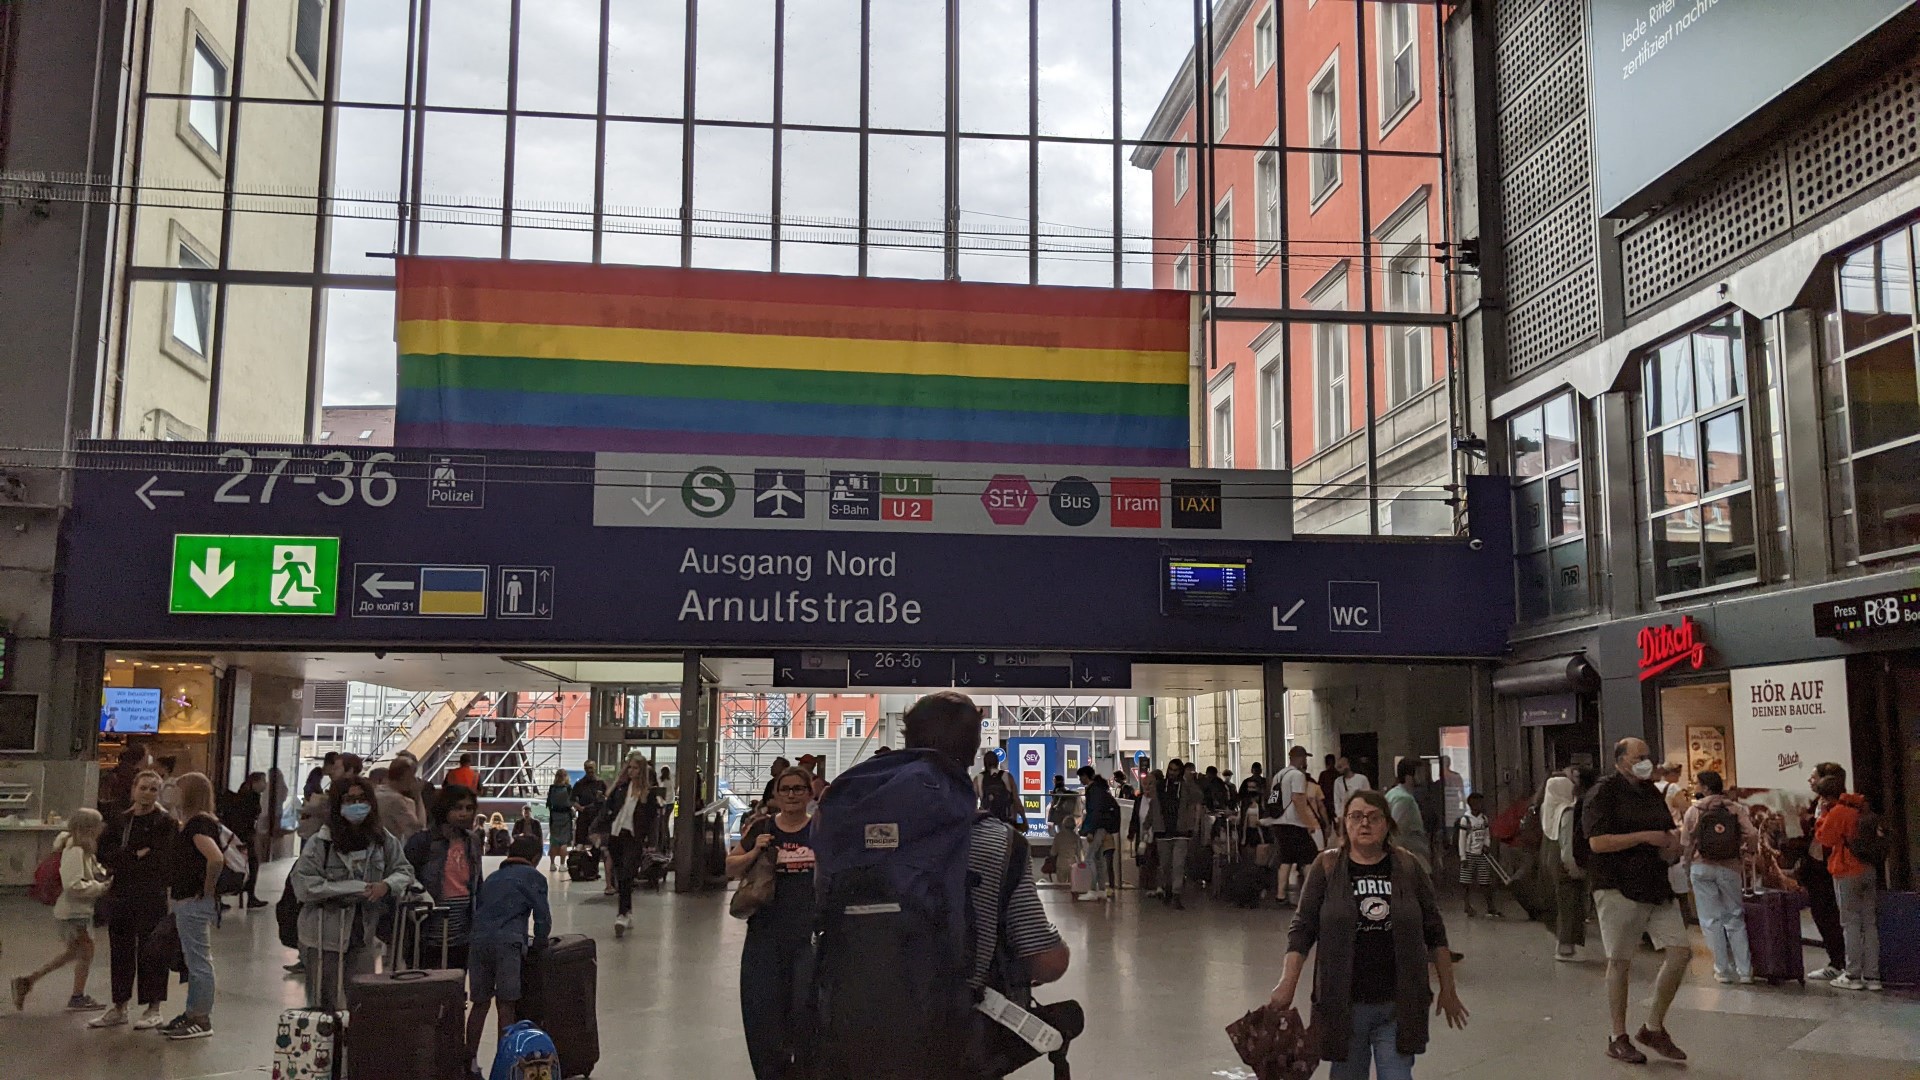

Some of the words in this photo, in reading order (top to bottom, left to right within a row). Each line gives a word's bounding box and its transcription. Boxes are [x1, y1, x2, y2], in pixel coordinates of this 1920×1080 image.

[1621, 18, 1647, 52] Jede
[1622, 24, 1673, 80] zertifiziert
[214, 449, 397, 507] 27-36
[432, 489, 474, 502] Polizei
[989, 488, 1028, 508] SEV
[1060, 493, 1092, 509] Bus
[1114, 494, 1158, 511] Tram
[831, 503, 869, 516] S-Bahn
[679, 547, 812, 581] Ausgang
[826, 550, 897, 577] Nord
[359, 601, 375, 612] До
[402, 602, 414, 611] 31
[678, 589, 922, 624] Arnulfstraße
[1833, 605, 1857, 618] Press
[1332, 606, 1369, 626] WC
[1637, 615, 1694, 670] Ditsch
[875, 652, 922, 668] 26-36
[1750, 679, 1786, 703] HÖR
[1790, 680, 1824, 701] AUF
[1752, 705, 1787, 718] DEINEN
[1789, 703, 1826, 716] BAUCH.
[1025, 753, 1039, 761] SEV
[1067, 759, 1077, 769] TAXI
[1778, 752, 1799, 769] Ditsch
[1024, 776, 1041, 785] Tram
[1025, 800, 1040, 808] TAXI
[1351, 879, 1392, 895] ORID
